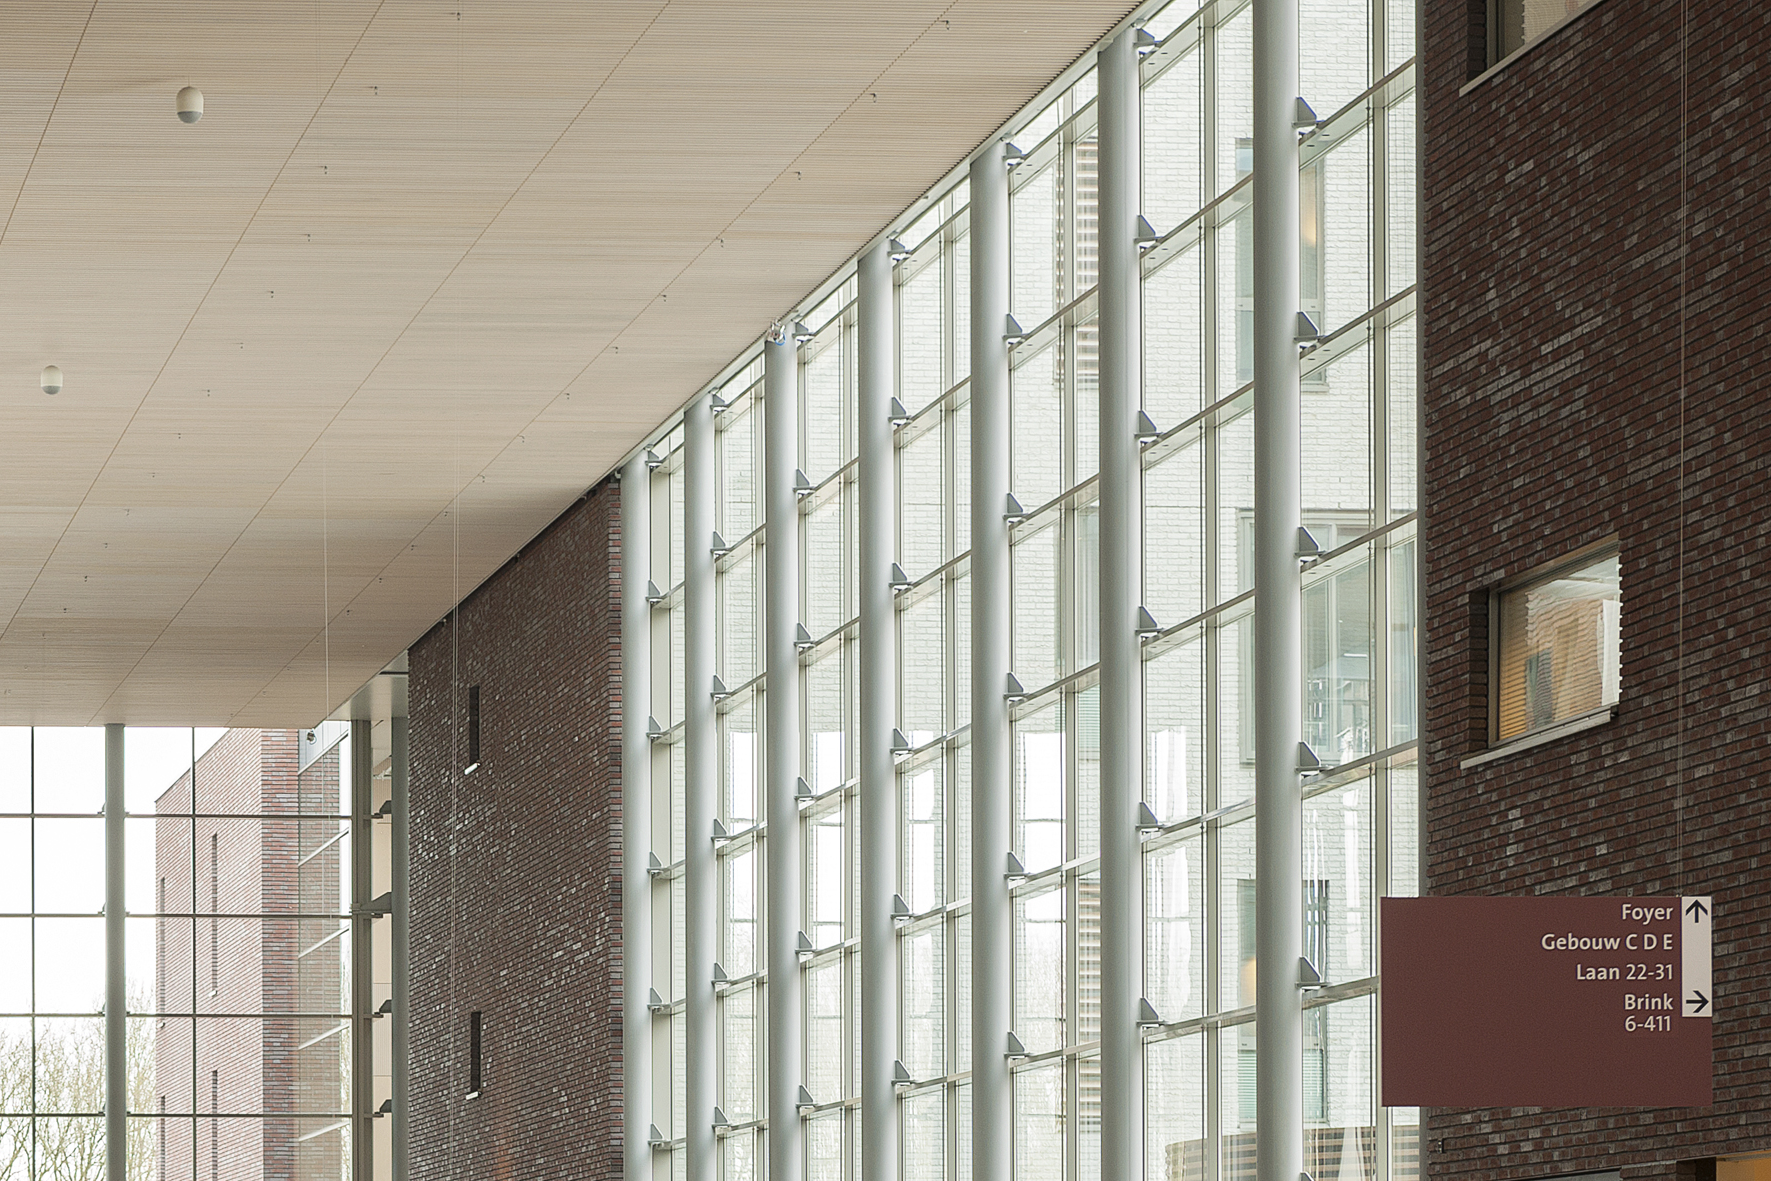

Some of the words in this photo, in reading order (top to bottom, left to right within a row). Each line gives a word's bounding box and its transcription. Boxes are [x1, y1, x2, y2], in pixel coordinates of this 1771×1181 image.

[1622, 903, 1674, 925] Foyer
[1541, 932, 1621, 950] Gebouw
[1625, 933, 1638, 950] C
[1644, 933, 1658, 950] D
[1663, 933, 1674, 950] E
[1576, 963, 1621, 980] Laan
[1625, 963, 1674, 981] 22-31
[1624, 993, 1674, 1010] Brink
[1625, 1015, 1671, 1032] 6-411
